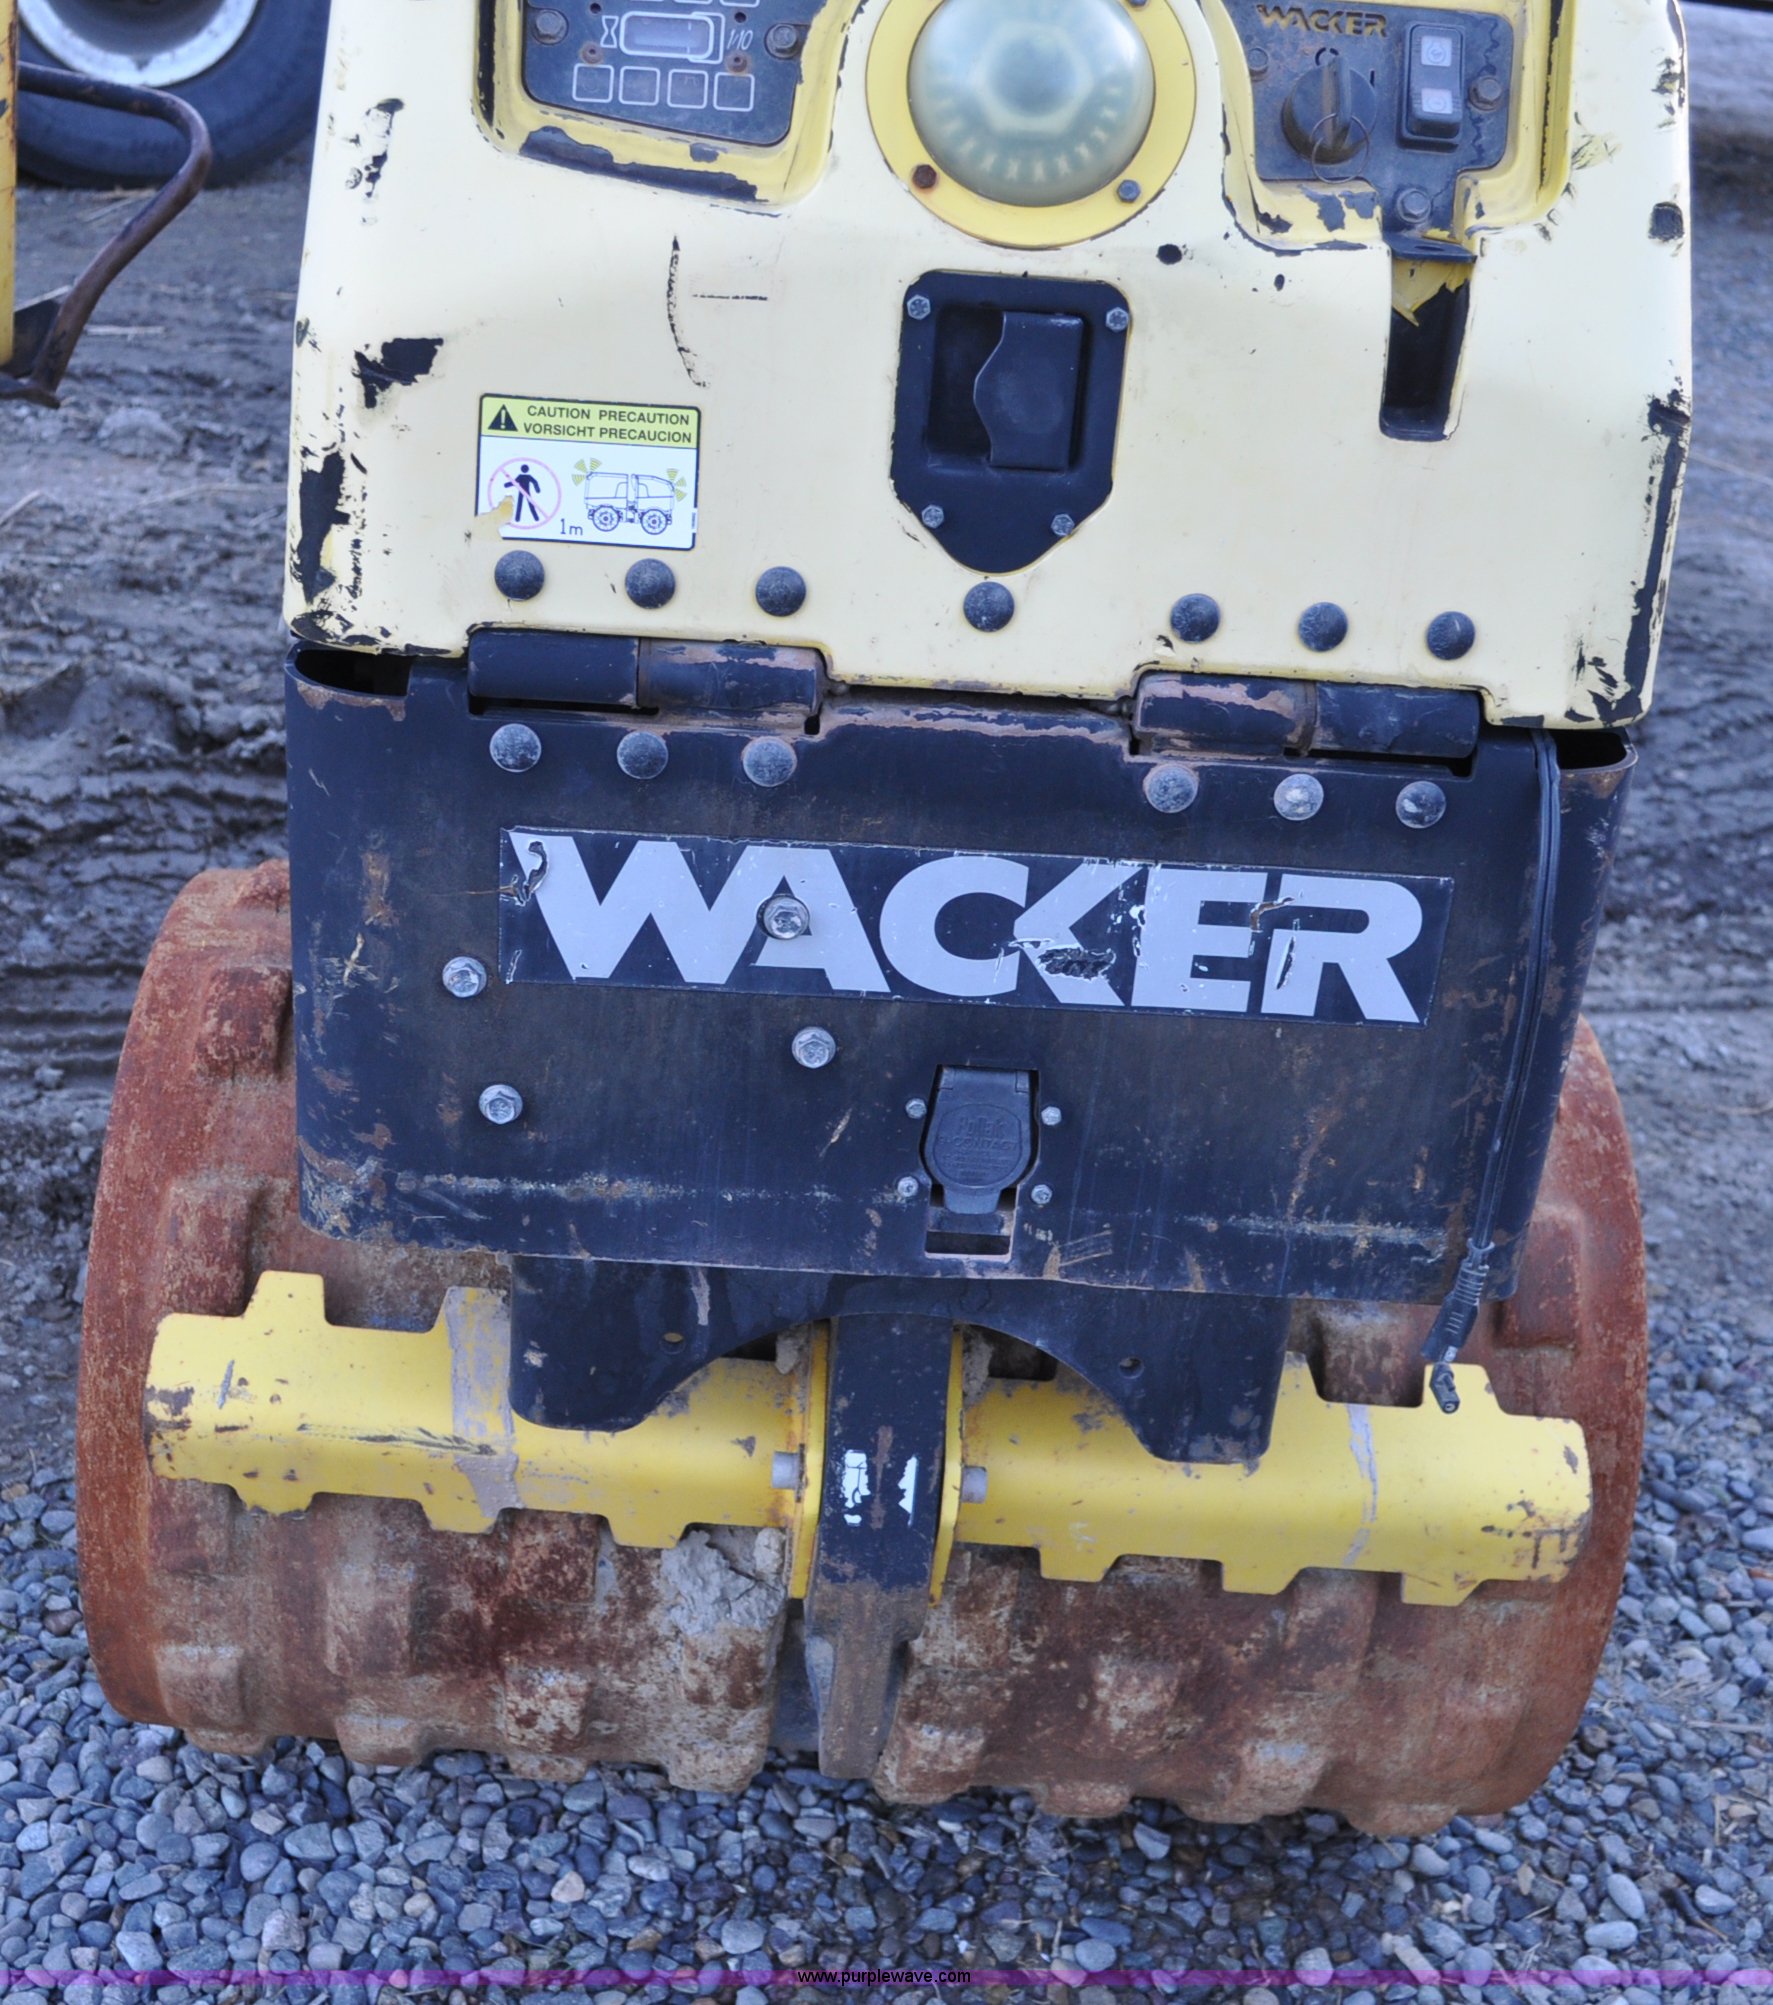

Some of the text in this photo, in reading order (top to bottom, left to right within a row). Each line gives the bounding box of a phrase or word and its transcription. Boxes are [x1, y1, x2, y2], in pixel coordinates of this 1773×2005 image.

[1256, 4, 1387, 37] WACKER
[526, 405, 690, 426] CAUTION PRECAUTION
[523, 422, 692, 444] VORSICHT PRECAUCION
[508, 830, 1420, 1023] WACKER
